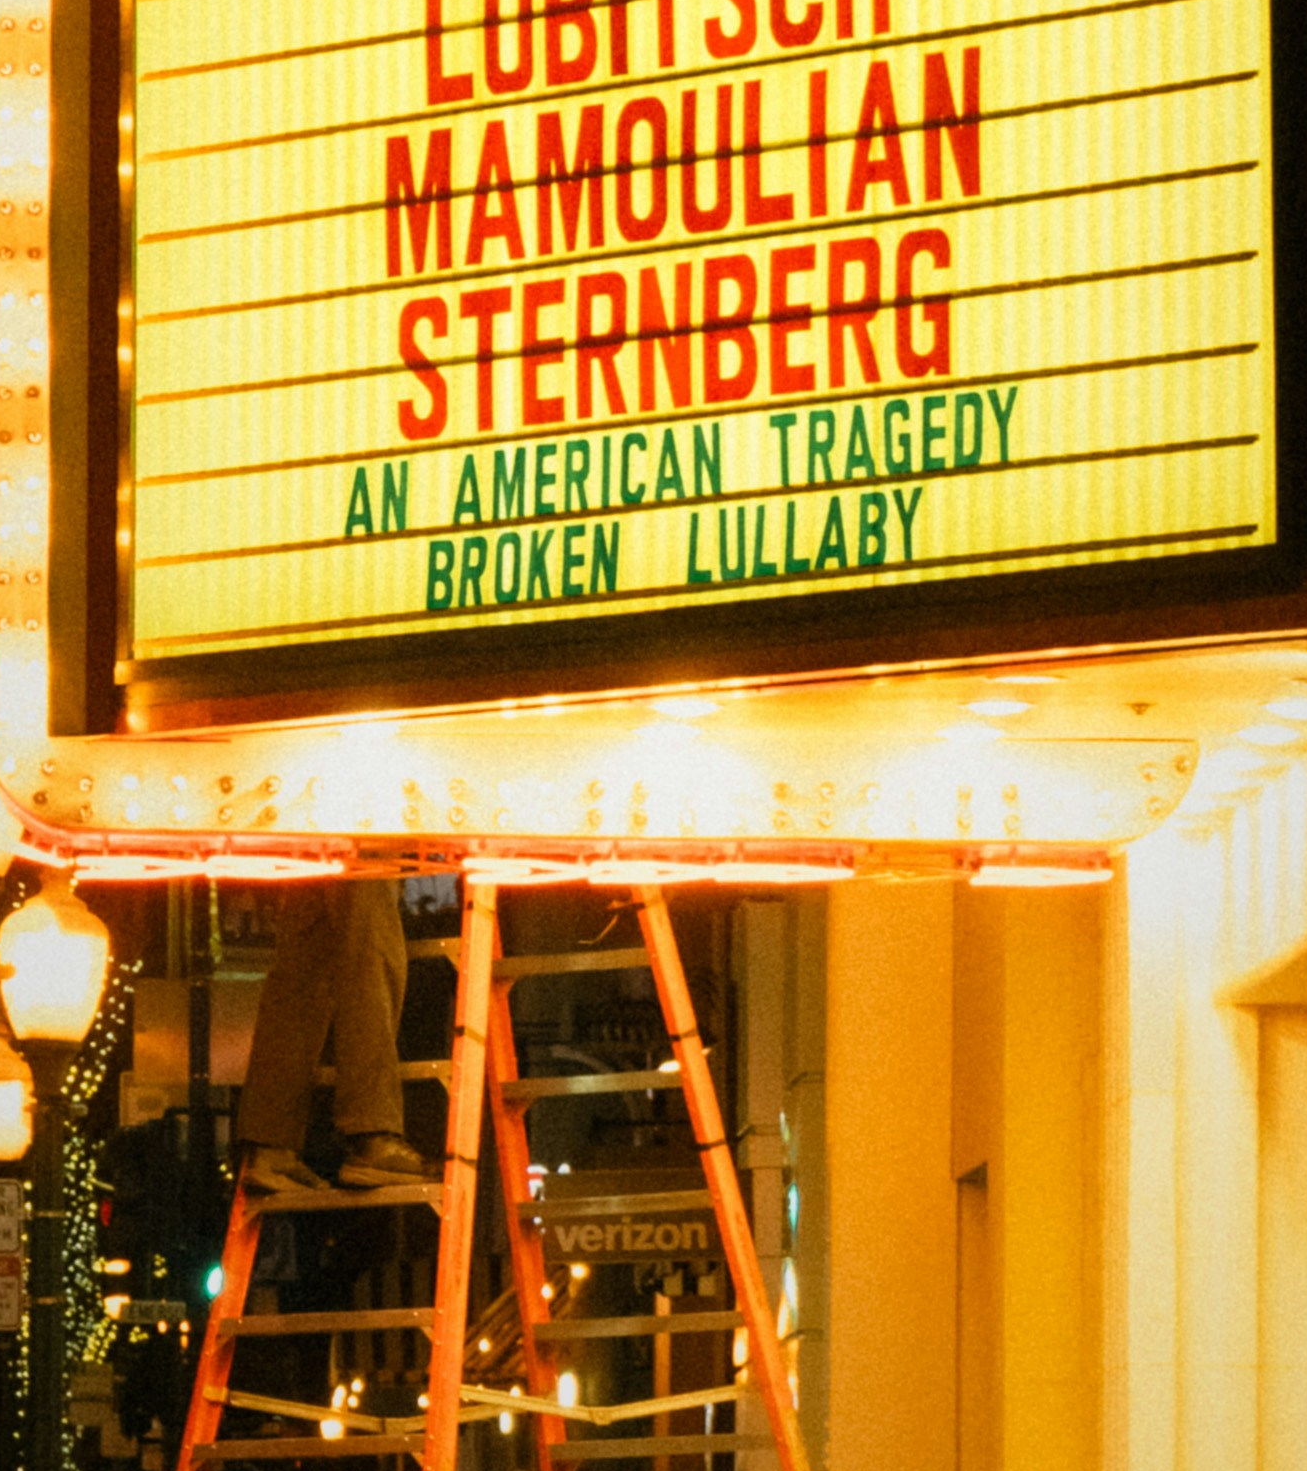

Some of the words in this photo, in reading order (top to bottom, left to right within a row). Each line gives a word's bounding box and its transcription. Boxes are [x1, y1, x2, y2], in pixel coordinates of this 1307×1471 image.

[386, 46, 981, 277] MAMOULIAN
[397, 228, 951, 441] STERNBERG
[345, 461, 408, 536] AN
[453, 422, 721, 526] AMERICAN
[770, 386, 1018, 488] TRAGEDY
[426, 521, 620, 610] BROKEN
[688, 486, 923, 584] LULLABY
[554, 1216, 709, 1253] verizon
